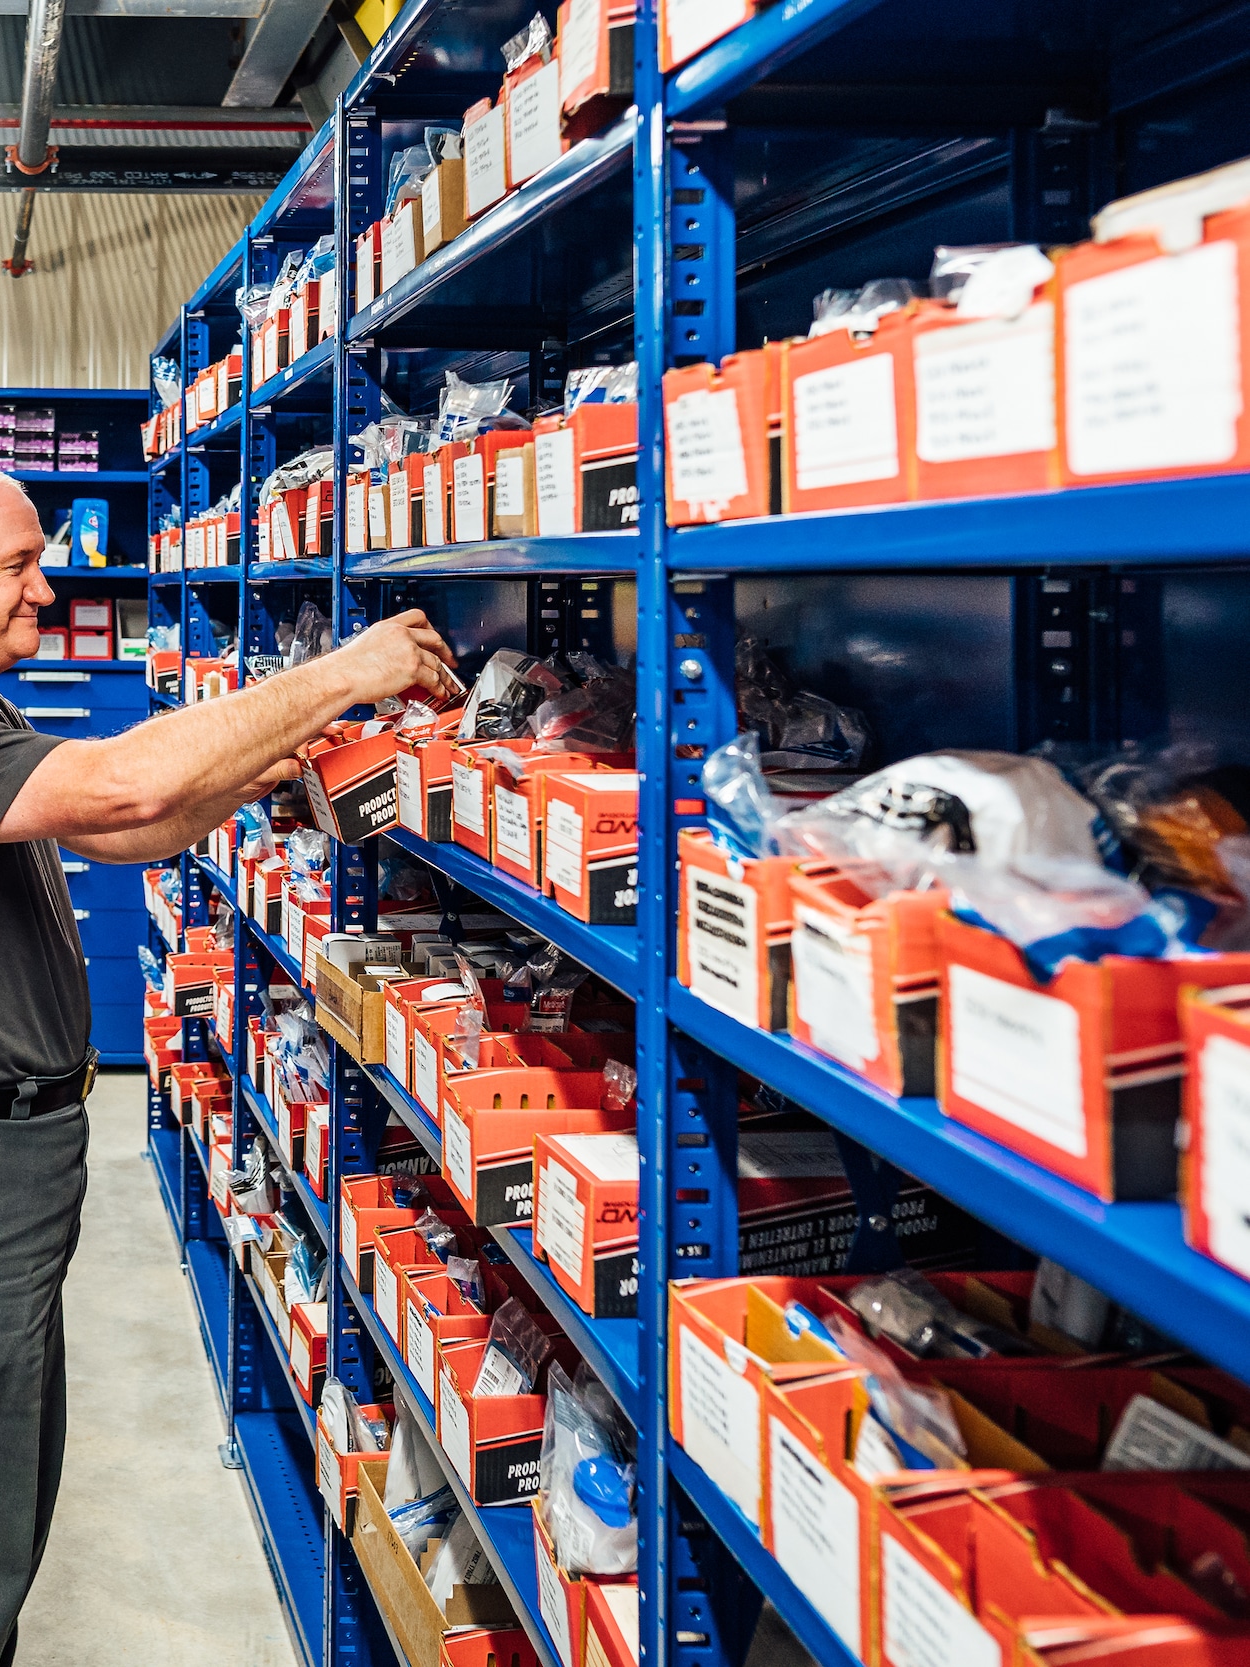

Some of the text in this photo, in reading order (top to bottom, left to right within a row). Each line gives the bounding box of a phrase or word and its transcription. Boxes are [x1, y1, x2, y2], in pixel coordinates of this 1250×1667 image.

[608, 485, 640, 506] PRO
[516, 1199, 533, 1217] PR
[517, 1477, 540, 1493] PRO
